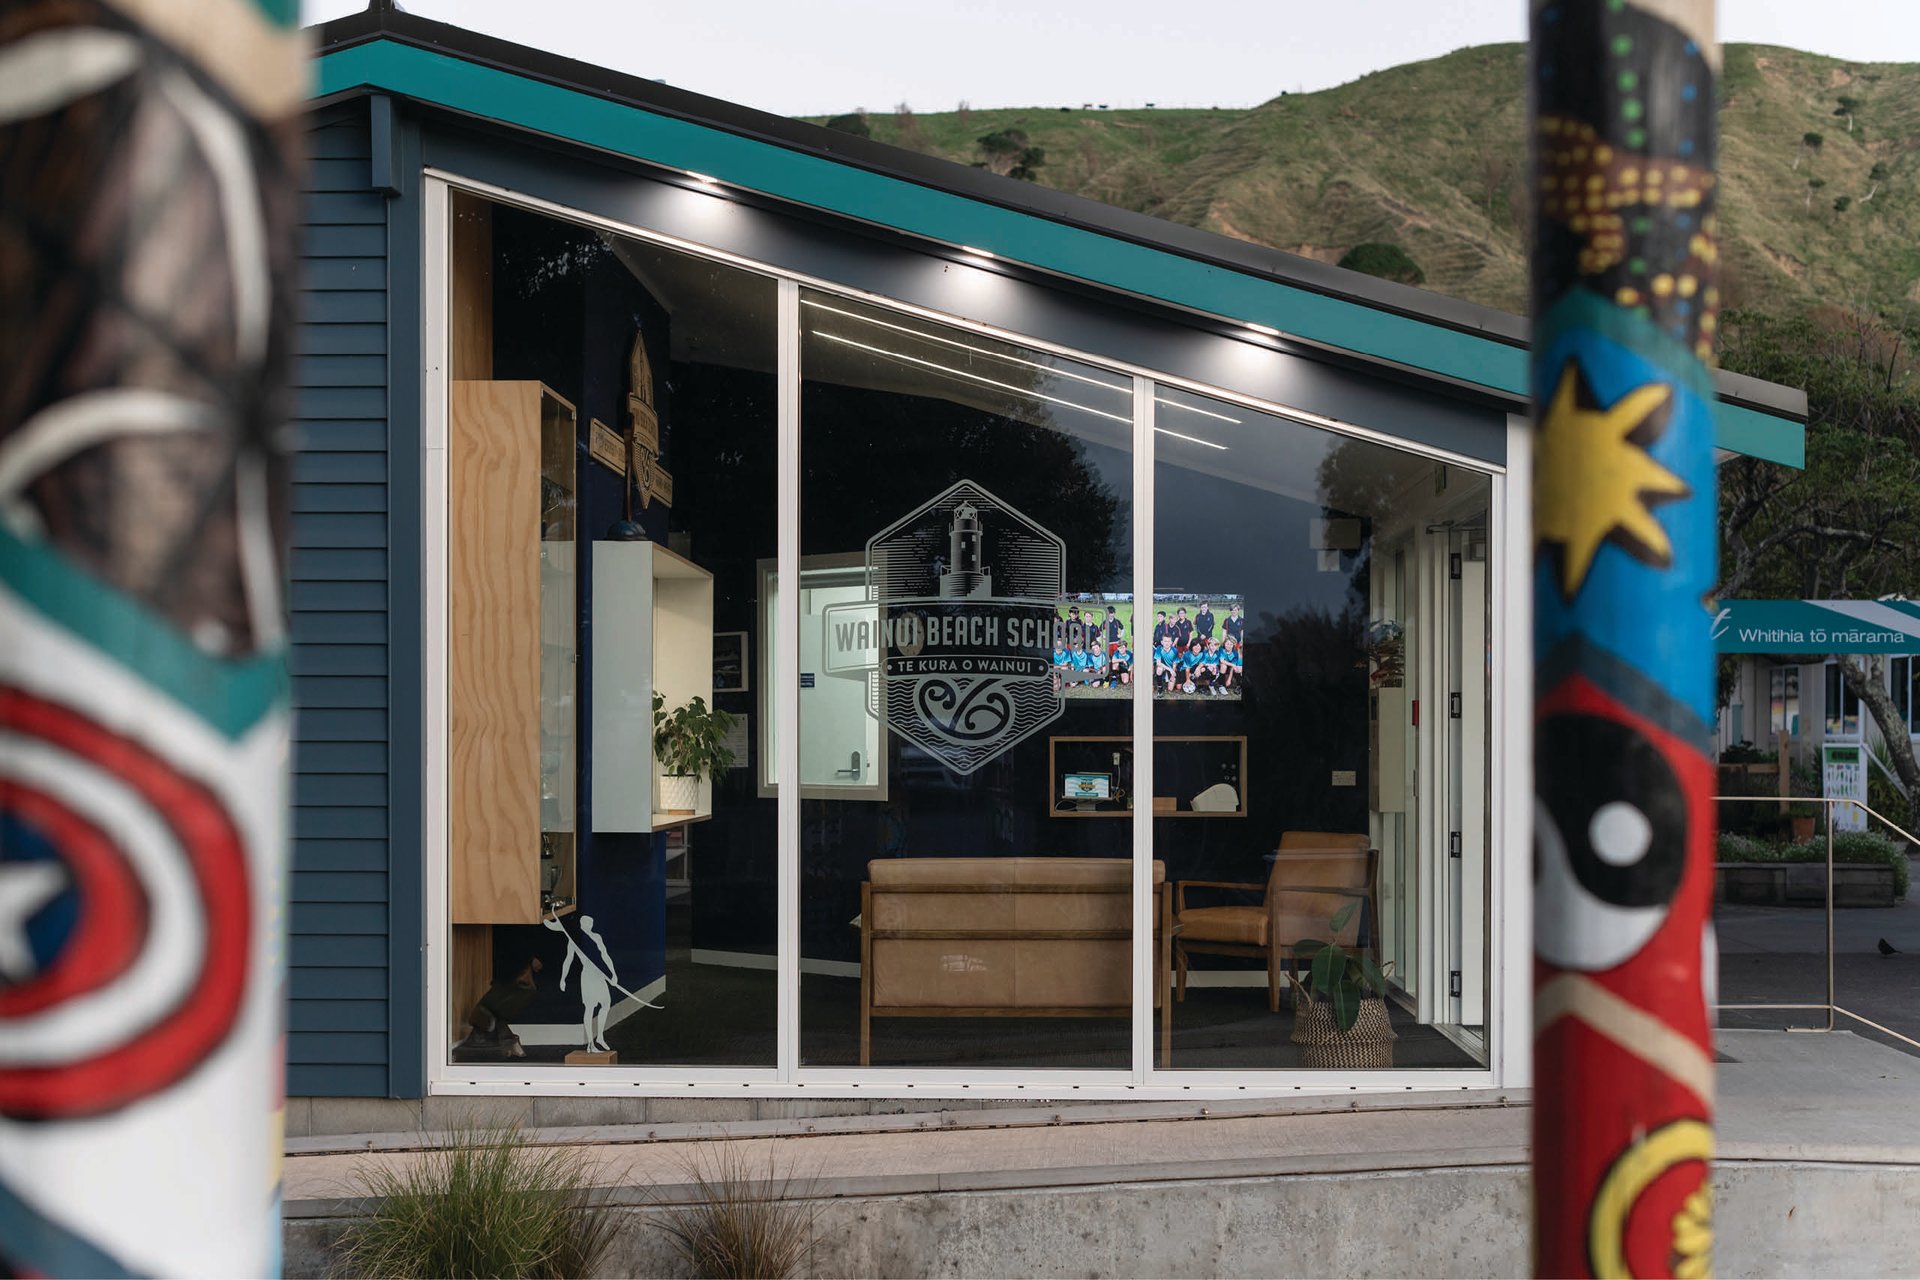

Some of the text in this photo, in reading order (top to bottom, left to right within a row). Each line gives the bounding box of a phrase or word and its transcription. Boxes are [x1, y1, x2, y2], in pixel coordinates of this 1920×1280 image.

[835, 616, 1094, 653] WAINUI BEACH SCHOOL
[1739, 628, 1905, 643] Whitihia tō mārama
[897, 659, 1031, 673] TE KURA O WAINUI
